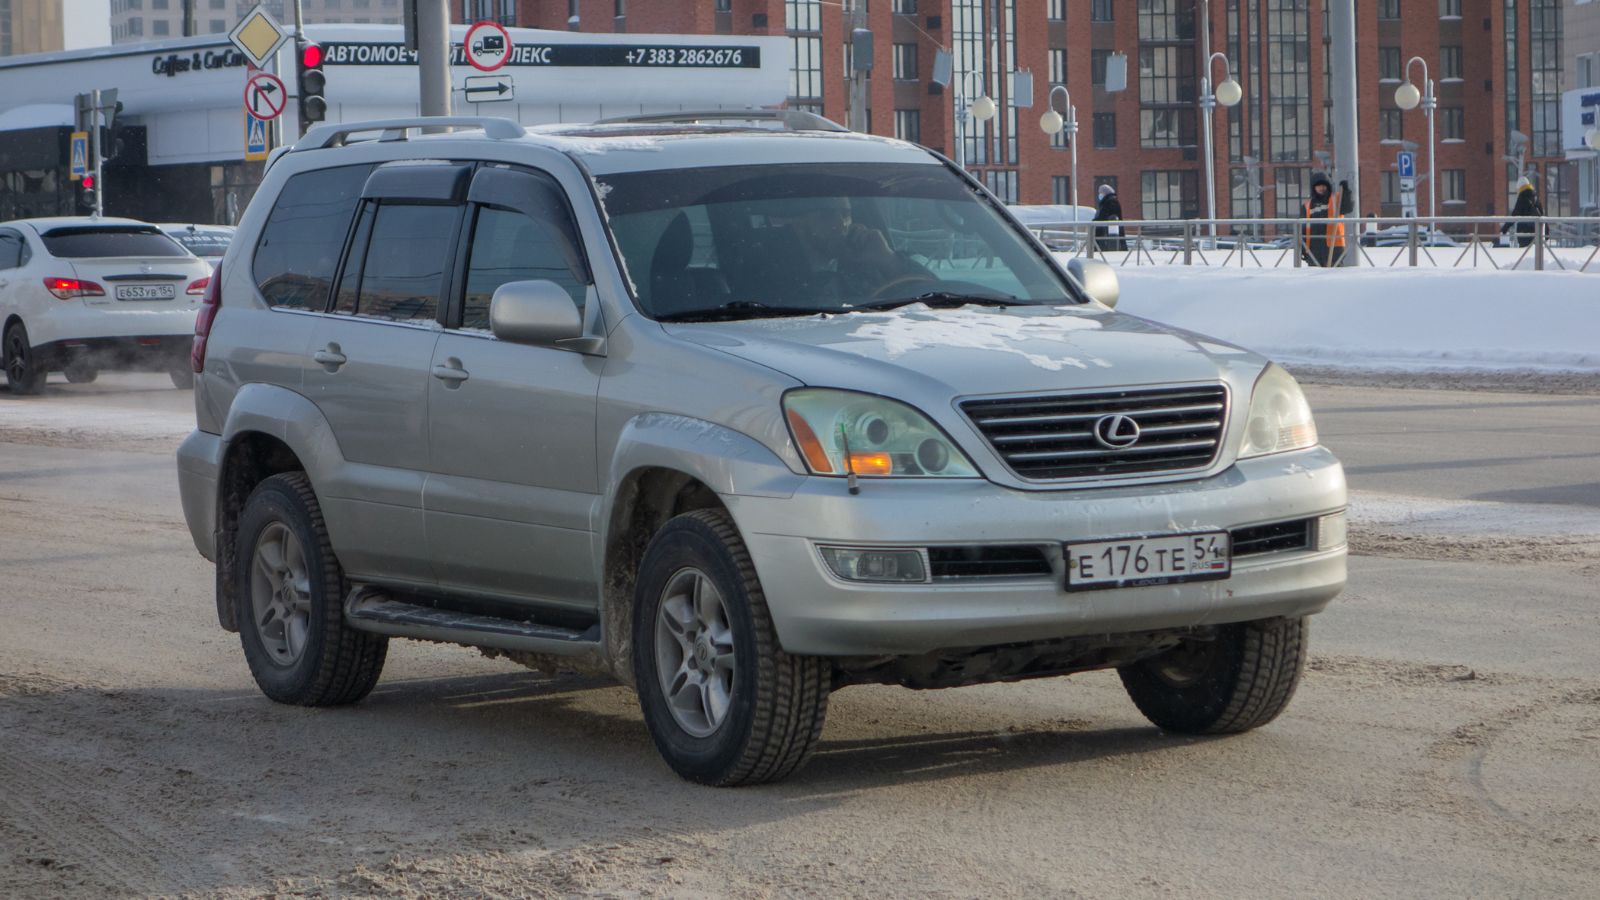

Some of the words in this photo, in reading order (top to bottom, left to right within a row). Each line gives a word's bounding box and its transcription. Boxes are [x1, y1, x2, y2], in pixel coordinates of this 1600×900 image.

[152, 55, 190, 76] Coffee
[625, 49, 646, 64] +7
[648, 49, 675, 64] 383
[678, 49, 742, 65] 2862676
[1193, 536, 1218, 560] 54
